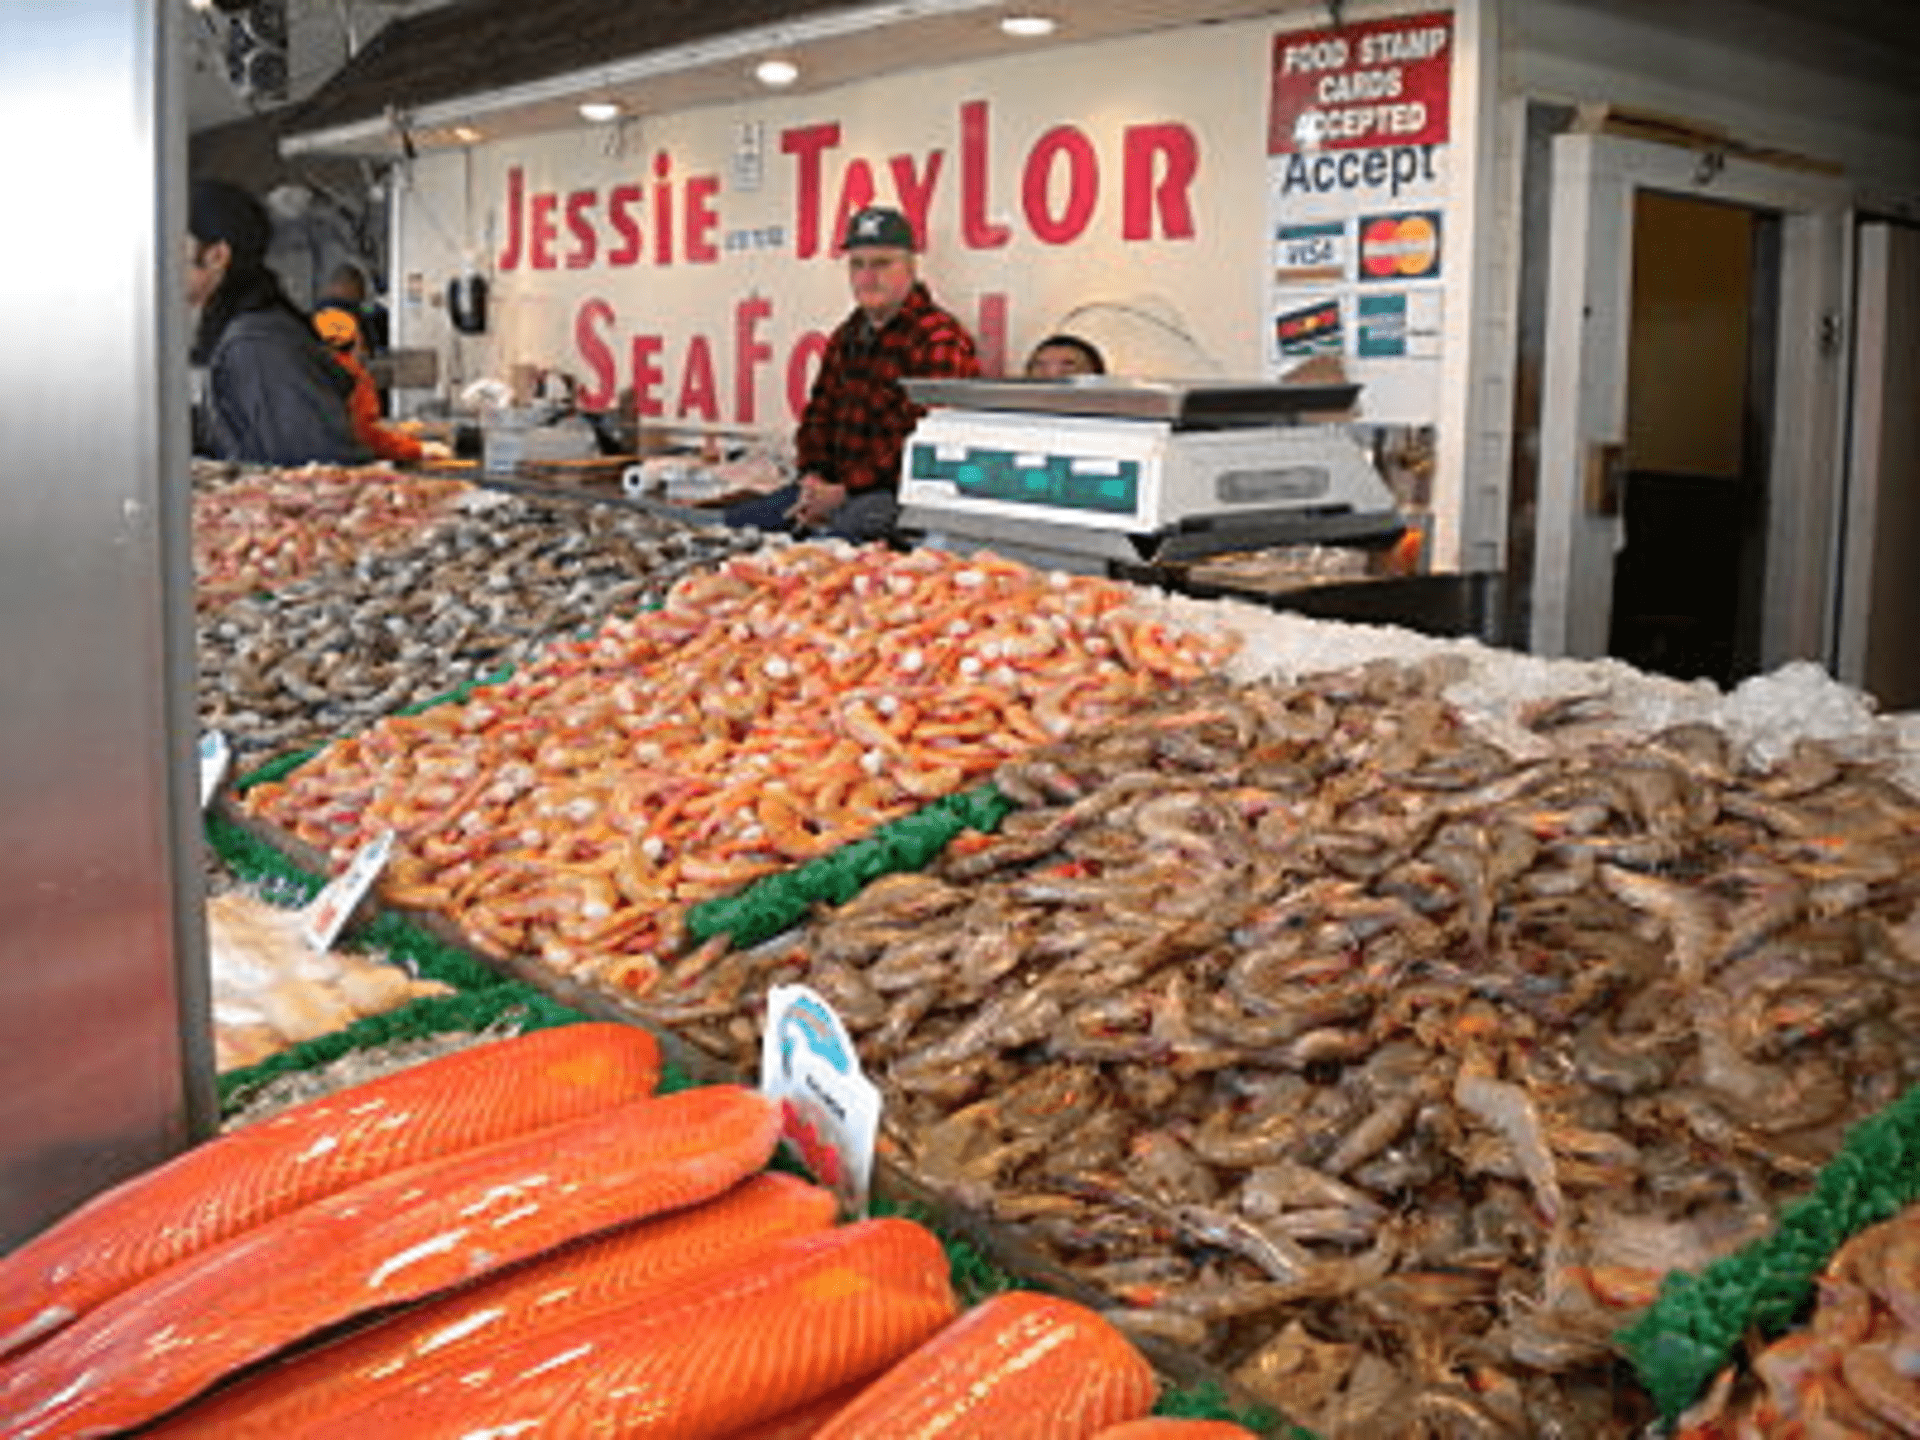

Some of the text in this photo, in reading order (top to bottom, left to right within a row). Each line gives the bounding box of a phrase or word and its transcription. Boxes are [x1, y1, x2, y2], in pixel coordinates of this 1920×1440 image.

[1282, 28, 1446, 77] FOOD STAMP
[1318, 67, 1402, 104] CARDS
[1281, 144, 1435, 197] Accept
[1287, 239, 1332, 265] VISA
[576, 292, 1008, 424] SEAFO
